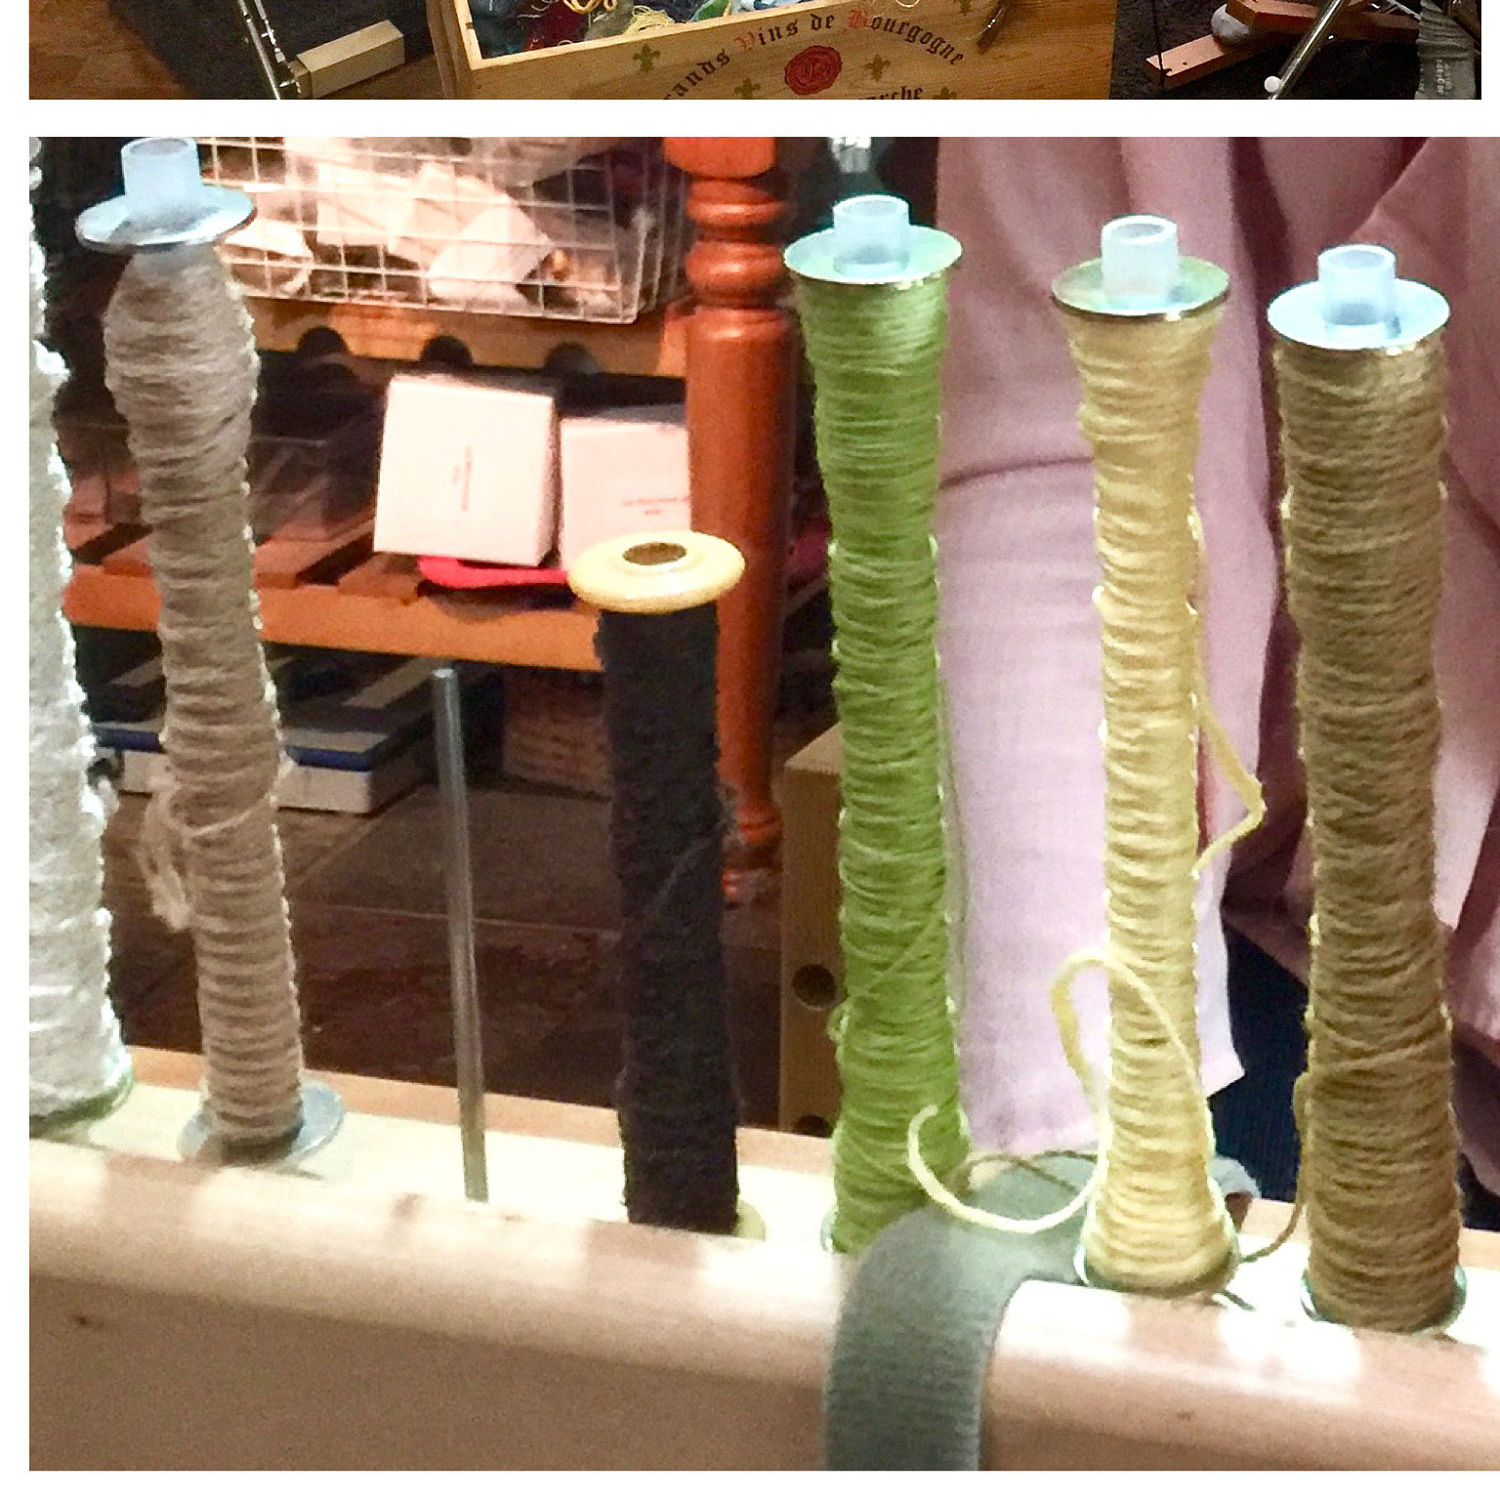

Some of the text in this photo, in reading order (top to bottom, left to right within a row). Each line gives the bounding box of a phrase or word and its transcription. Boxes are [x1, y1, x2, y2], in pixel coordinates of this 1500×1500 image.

[735, 19, 799, 53] Vins
[810, 13, 836, 31] de
[847, 7, 965, 65] Bourgogne
